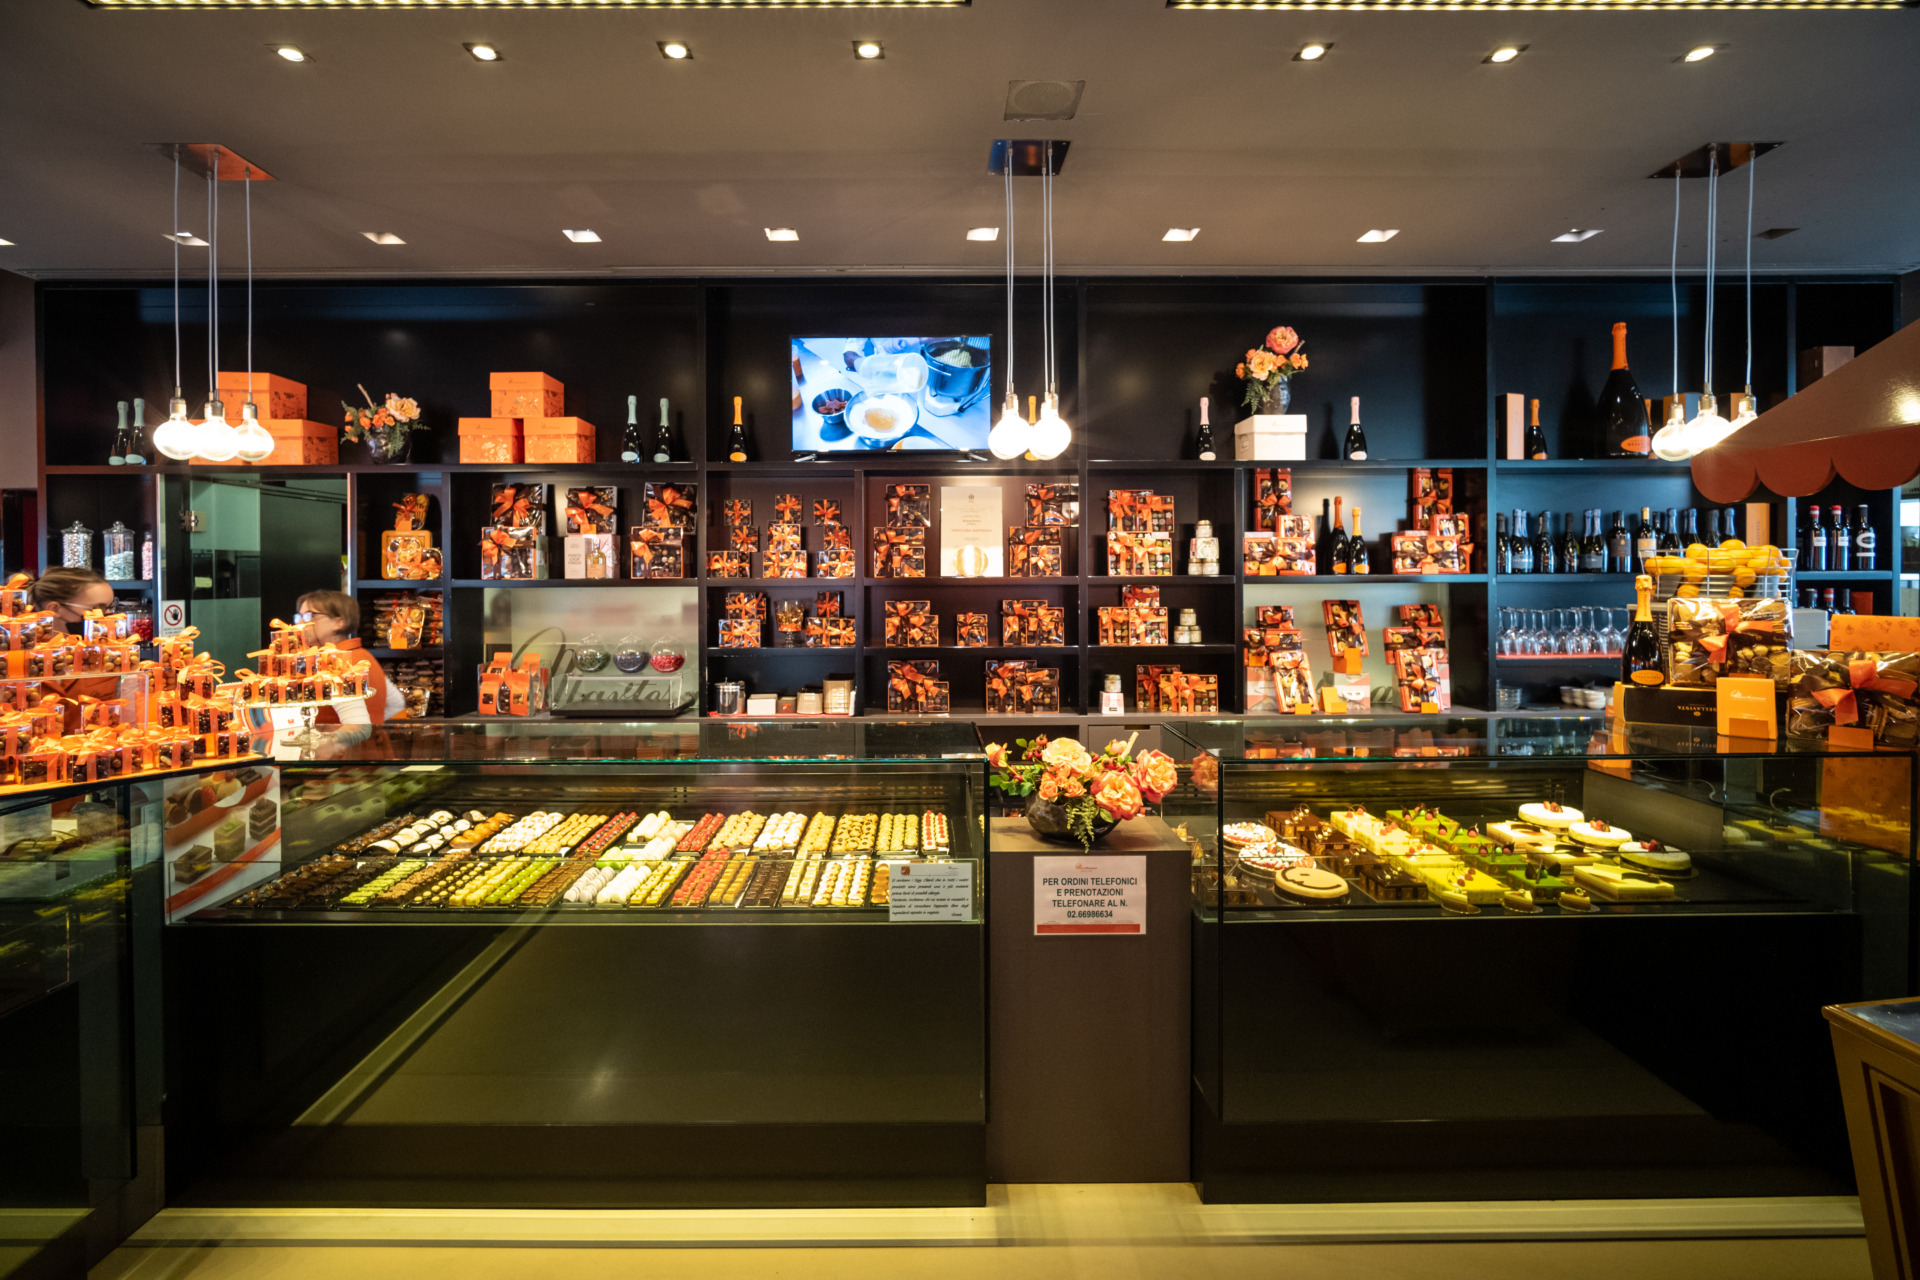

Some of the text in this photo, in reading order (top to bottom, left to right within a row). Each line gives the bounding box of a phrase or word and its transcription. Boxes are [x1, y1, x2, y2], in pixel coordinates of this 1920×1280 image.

[1042, 878, 1137, 886] PER ORDINI TELEFONICI
[1056, 888, 1123, 897] E PRENOTAZIONI
[1052, 899, 1128, 908] TELEFONARE AL N.
[1067, 910, 1113, 918] 02.66986634
